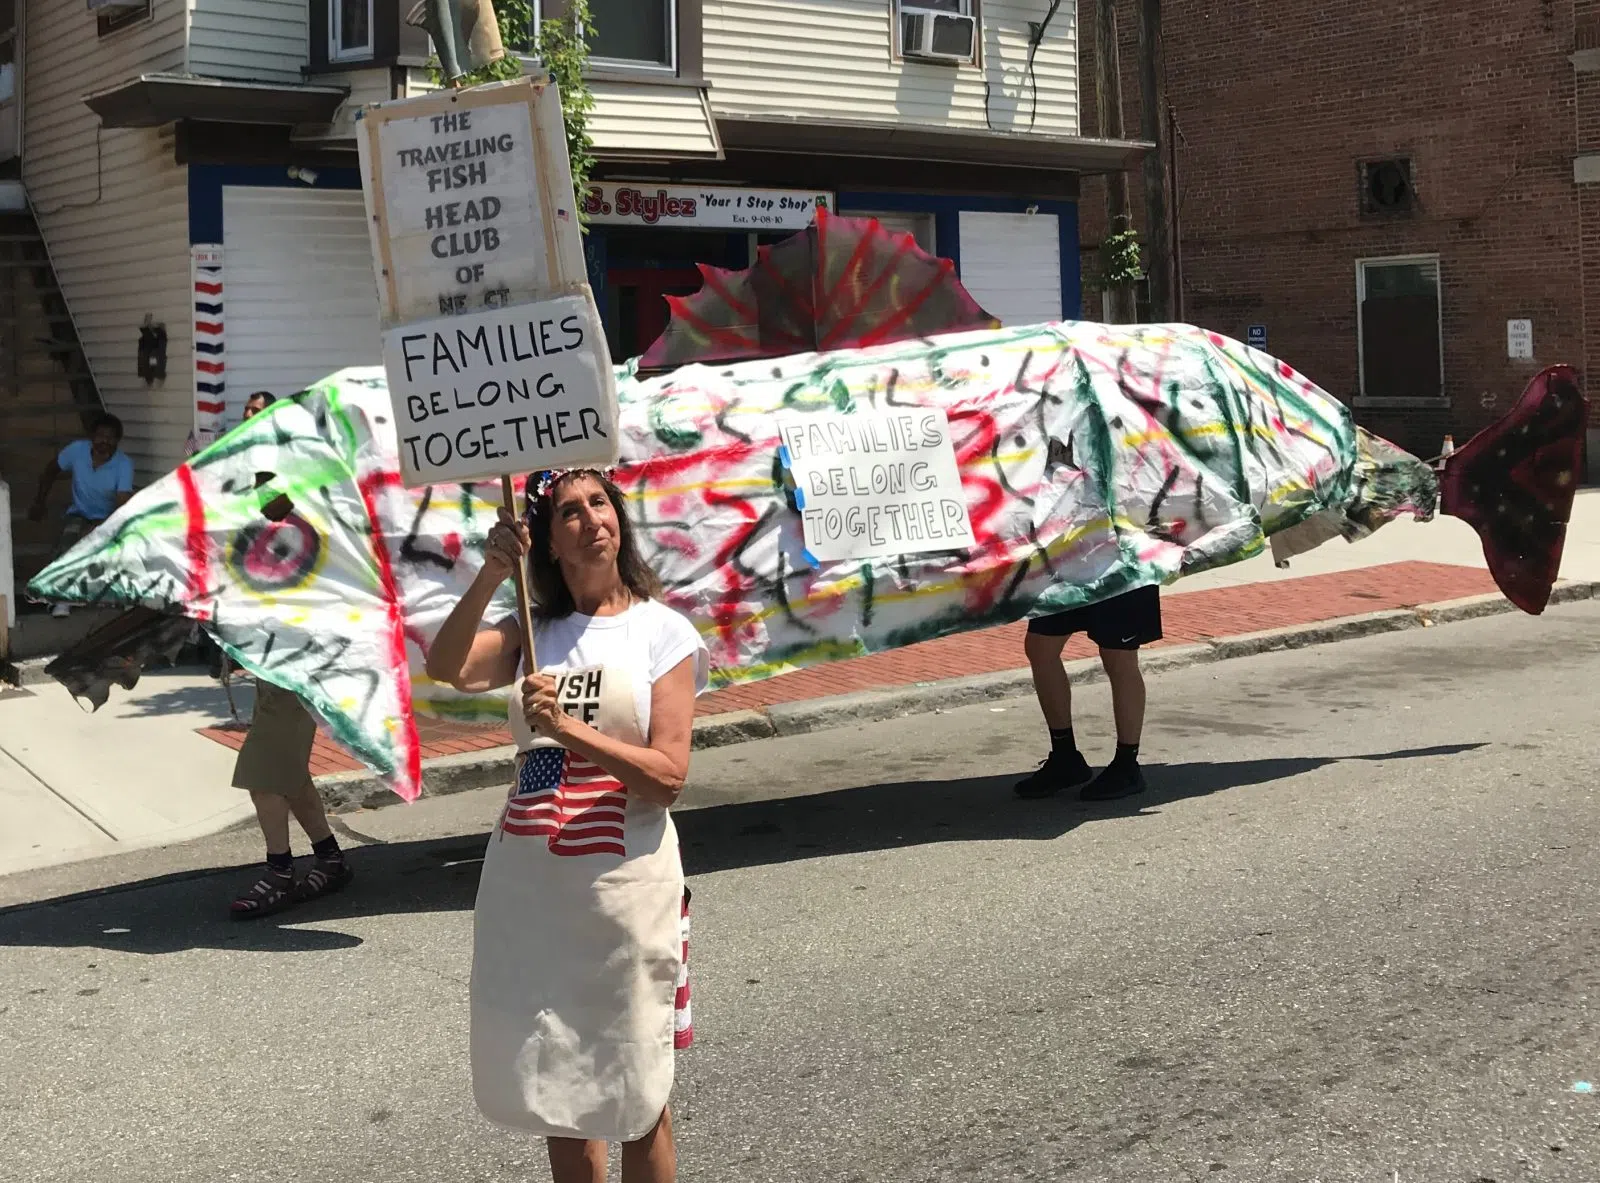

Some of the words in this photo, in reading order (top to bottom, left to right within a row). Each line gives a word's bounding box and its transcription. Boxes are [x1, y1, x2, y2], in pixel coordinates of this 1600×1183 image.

[430, 111, 471, 134] THE
[397, 133, 514, 168] TRAVELING
[426, 161, 487, 193] FISH
[425, 196, 501, 230] HEAD
[615, 188, 697, 225] Stylez
[700, 194, 731, 208] "Your
[736, 197, 742, 208] 1
[747, 196, 774, 211] Stop
[780, 197, 812, 212] Shop"
[732, 214, 748, 223] Est.
[751, 215, 783, 224] 9-08-10
[430, 227, 500, 258] CLUB
[456, 264, 484, 284] OF
[439, 295, 467, 315] NE
[484, 288, 510, 309] CT
[1252, 328, 1262, 336] NO
[1513, 323, 1526, 331] NO
[401, 315, 584, 382] FAMILIES
[407, 372, 566, 422] BELONG
[404, 407, 607, 472] TOGETHER
[785, 415, 943, 460] FAMILIES
[808, 461, 938, 496] BELONG
[805, 499, 968, 546] TOGETHER
[542, 669, 602, 699] ISH
